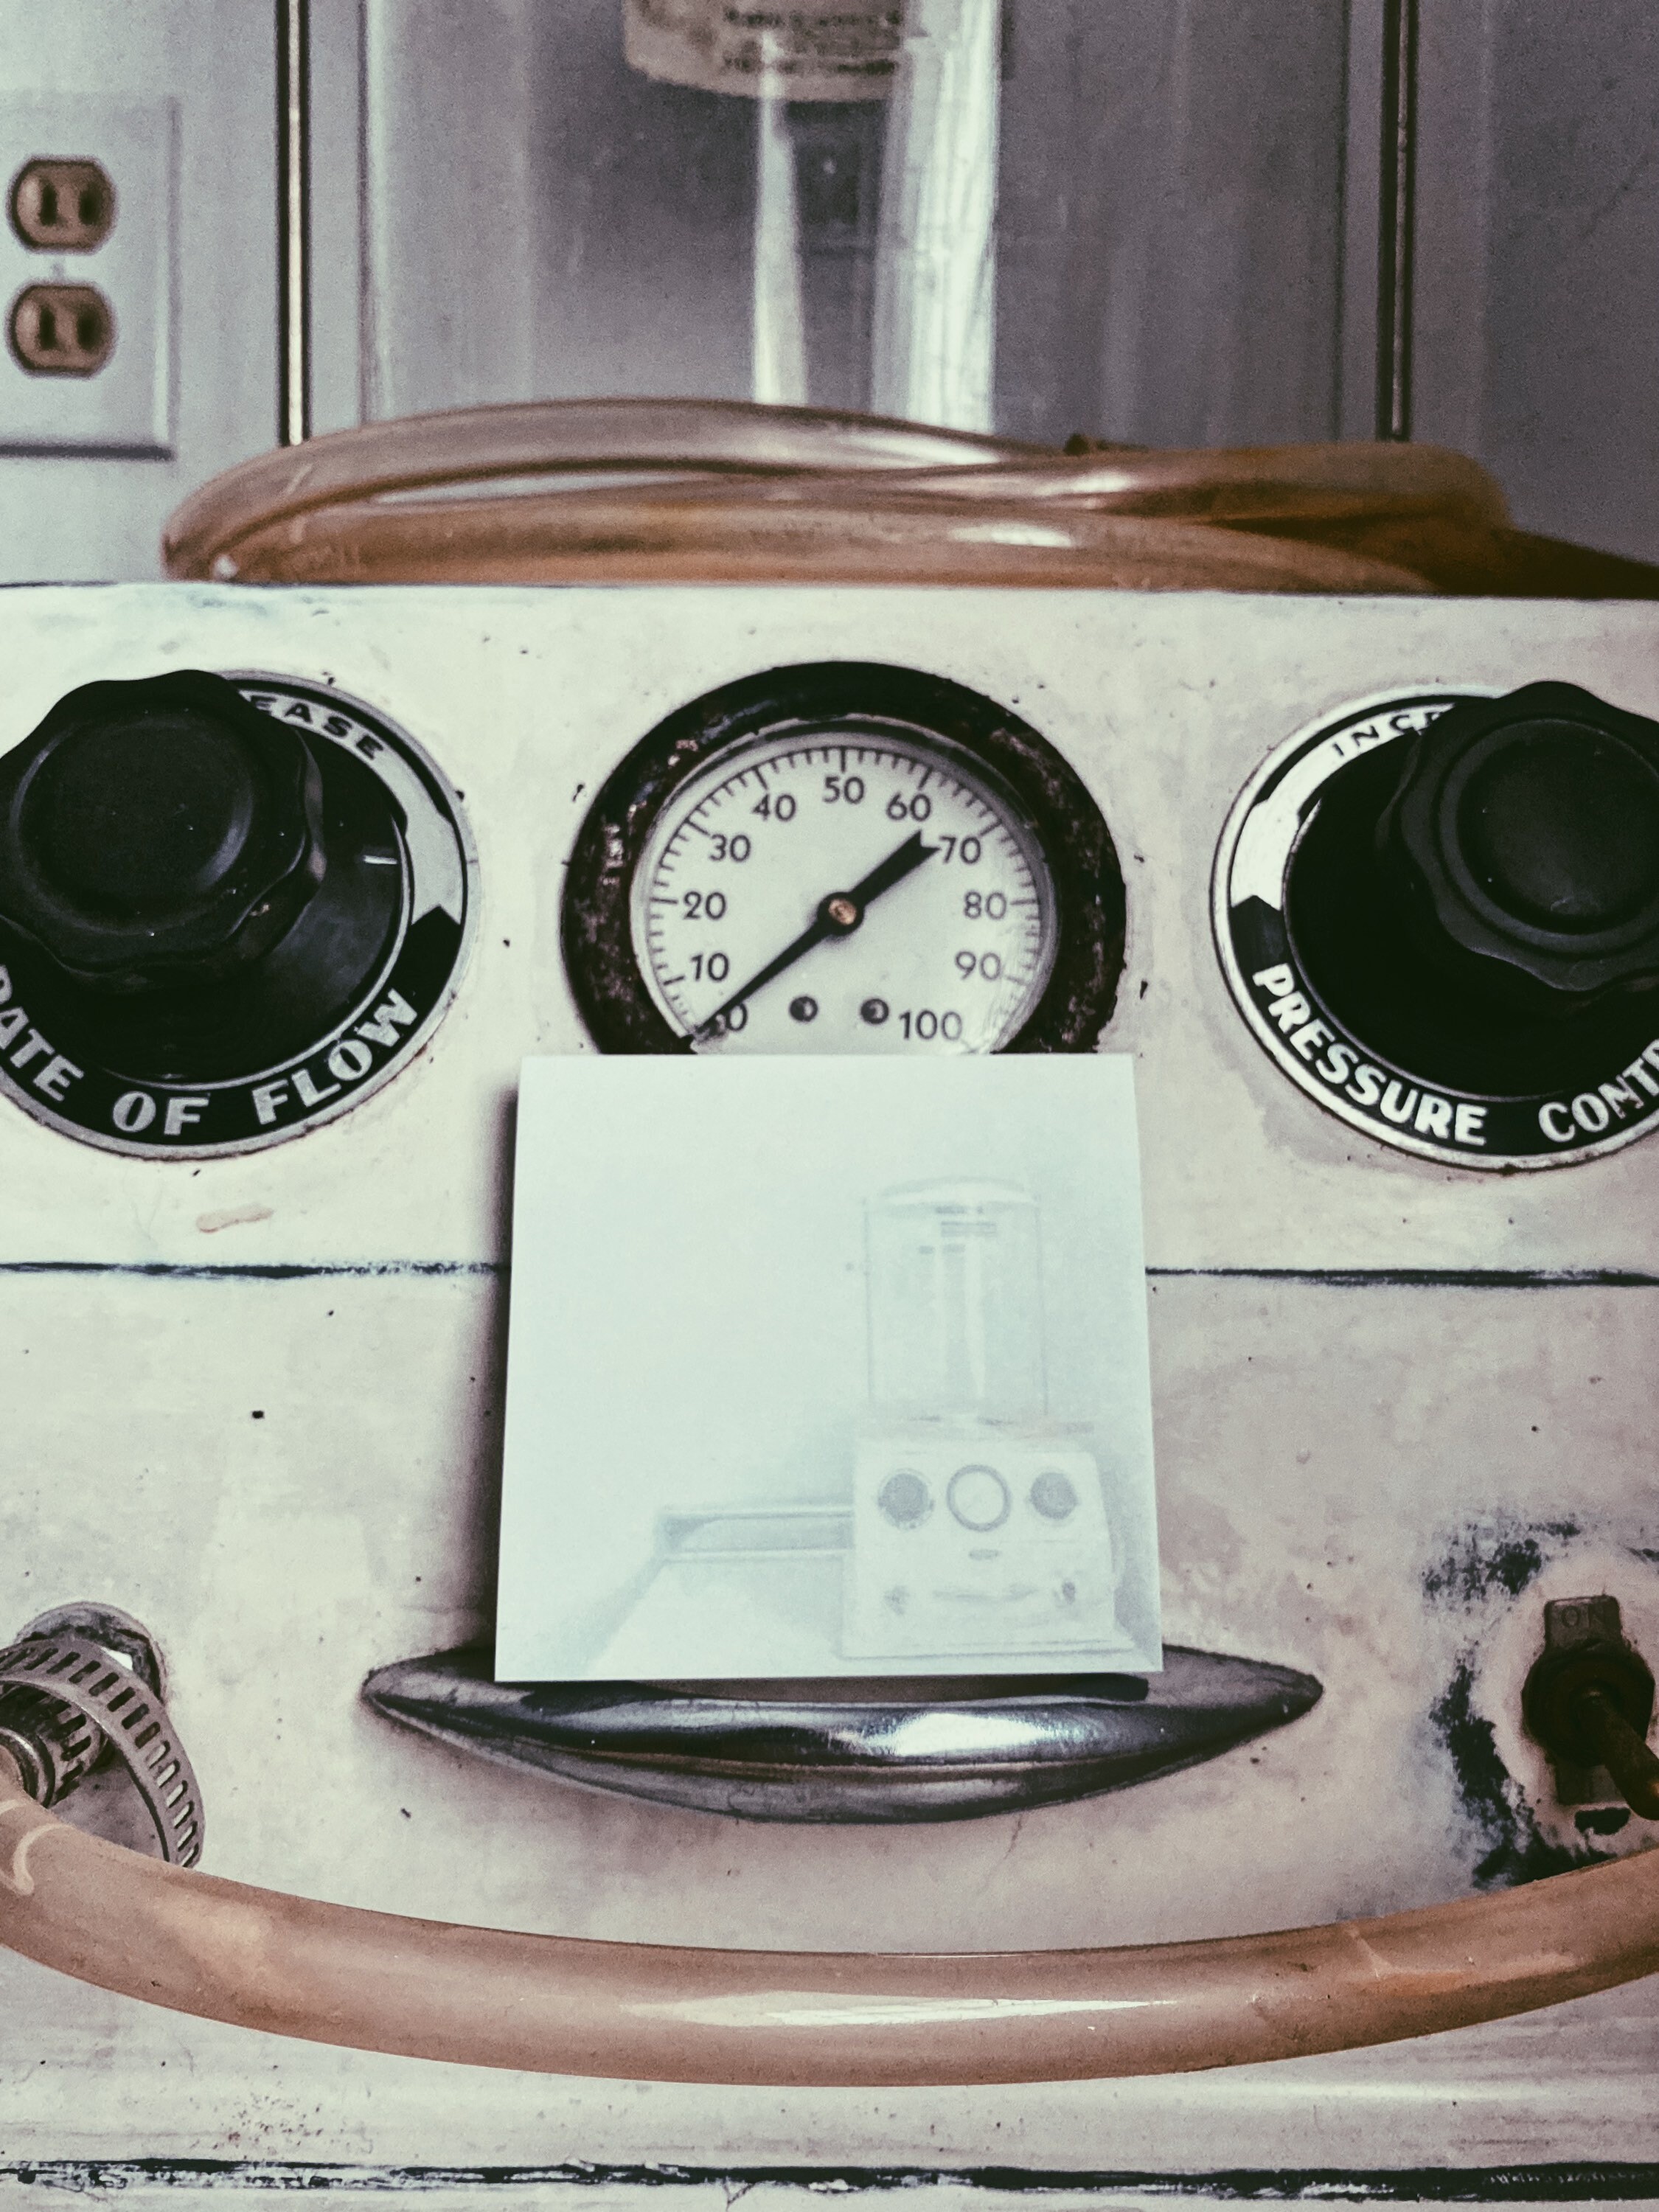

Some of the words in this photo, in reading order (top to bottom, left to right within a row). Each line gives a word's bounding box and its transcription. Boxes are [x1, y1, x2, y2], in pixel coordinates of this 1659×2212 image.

[823, 776, 865, 804] 50
[752, 793, 796, 822] 40
[886, 793, 932, 822] 60
[709, 834, 751, 862] 30
[939, 837, 981, 863] 70
[683, 891, 727, 920] 20
[963, 893, 1007, 919] 80
[691, 953, 729, 981] 10
[955, 952, 1001, 981] 90
[898, 1010, 962, 1040] 100
[113, 1091, 209, 1135] OF
[252, 988, 417, 1125] FLOW
[1253, 963, 1488, 1145] PRESSURE
